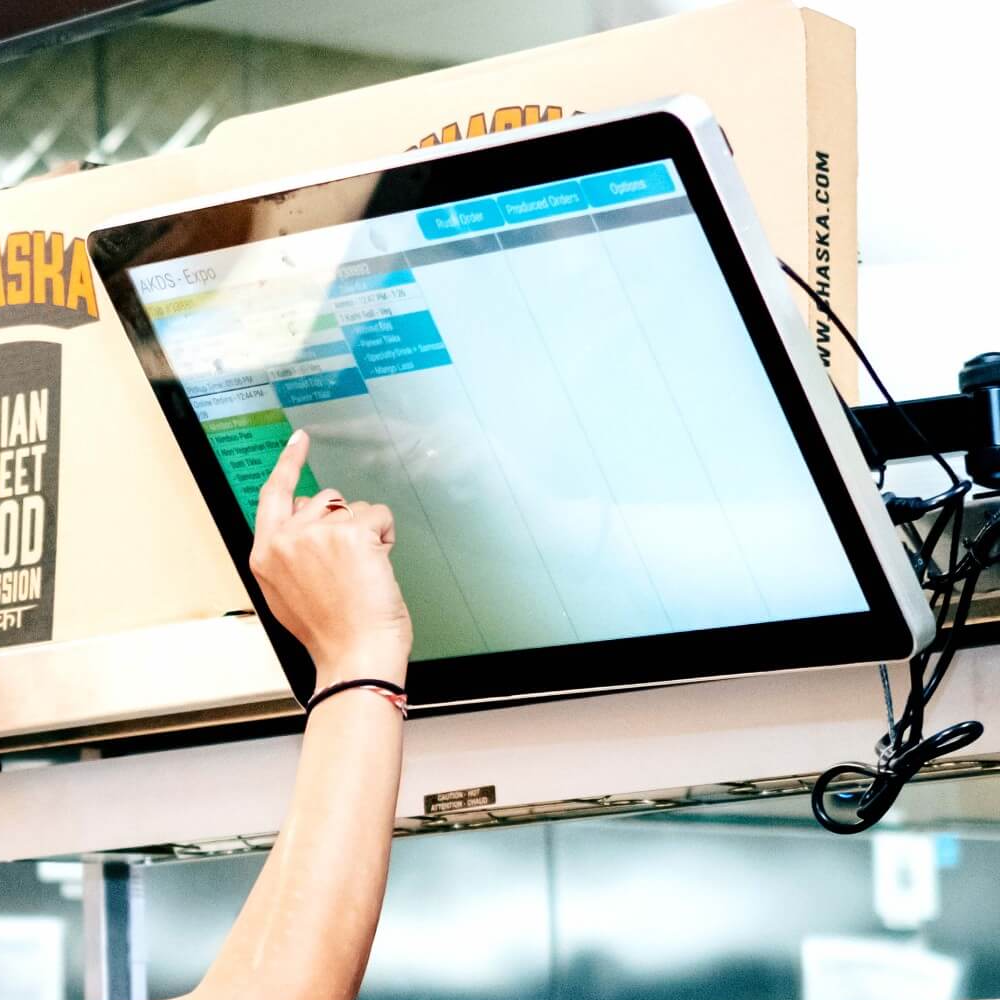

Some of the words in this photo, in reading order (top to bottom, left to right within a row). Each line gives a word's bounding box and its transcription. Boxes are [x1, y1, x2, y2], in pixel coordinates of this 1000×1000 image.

[608, 178, 647, 196] Options
[505, 197, 549, 216] Produced
[548, 191, 580, 211] Orders
[140, 272, 176, 294] AKDS
[181, 267, 217, 287] Expo
[437, 791, 463, 802] CAUTION
[467, 788, 481, 798] HOT
[431, 800, 463, 812] ATTENTION
